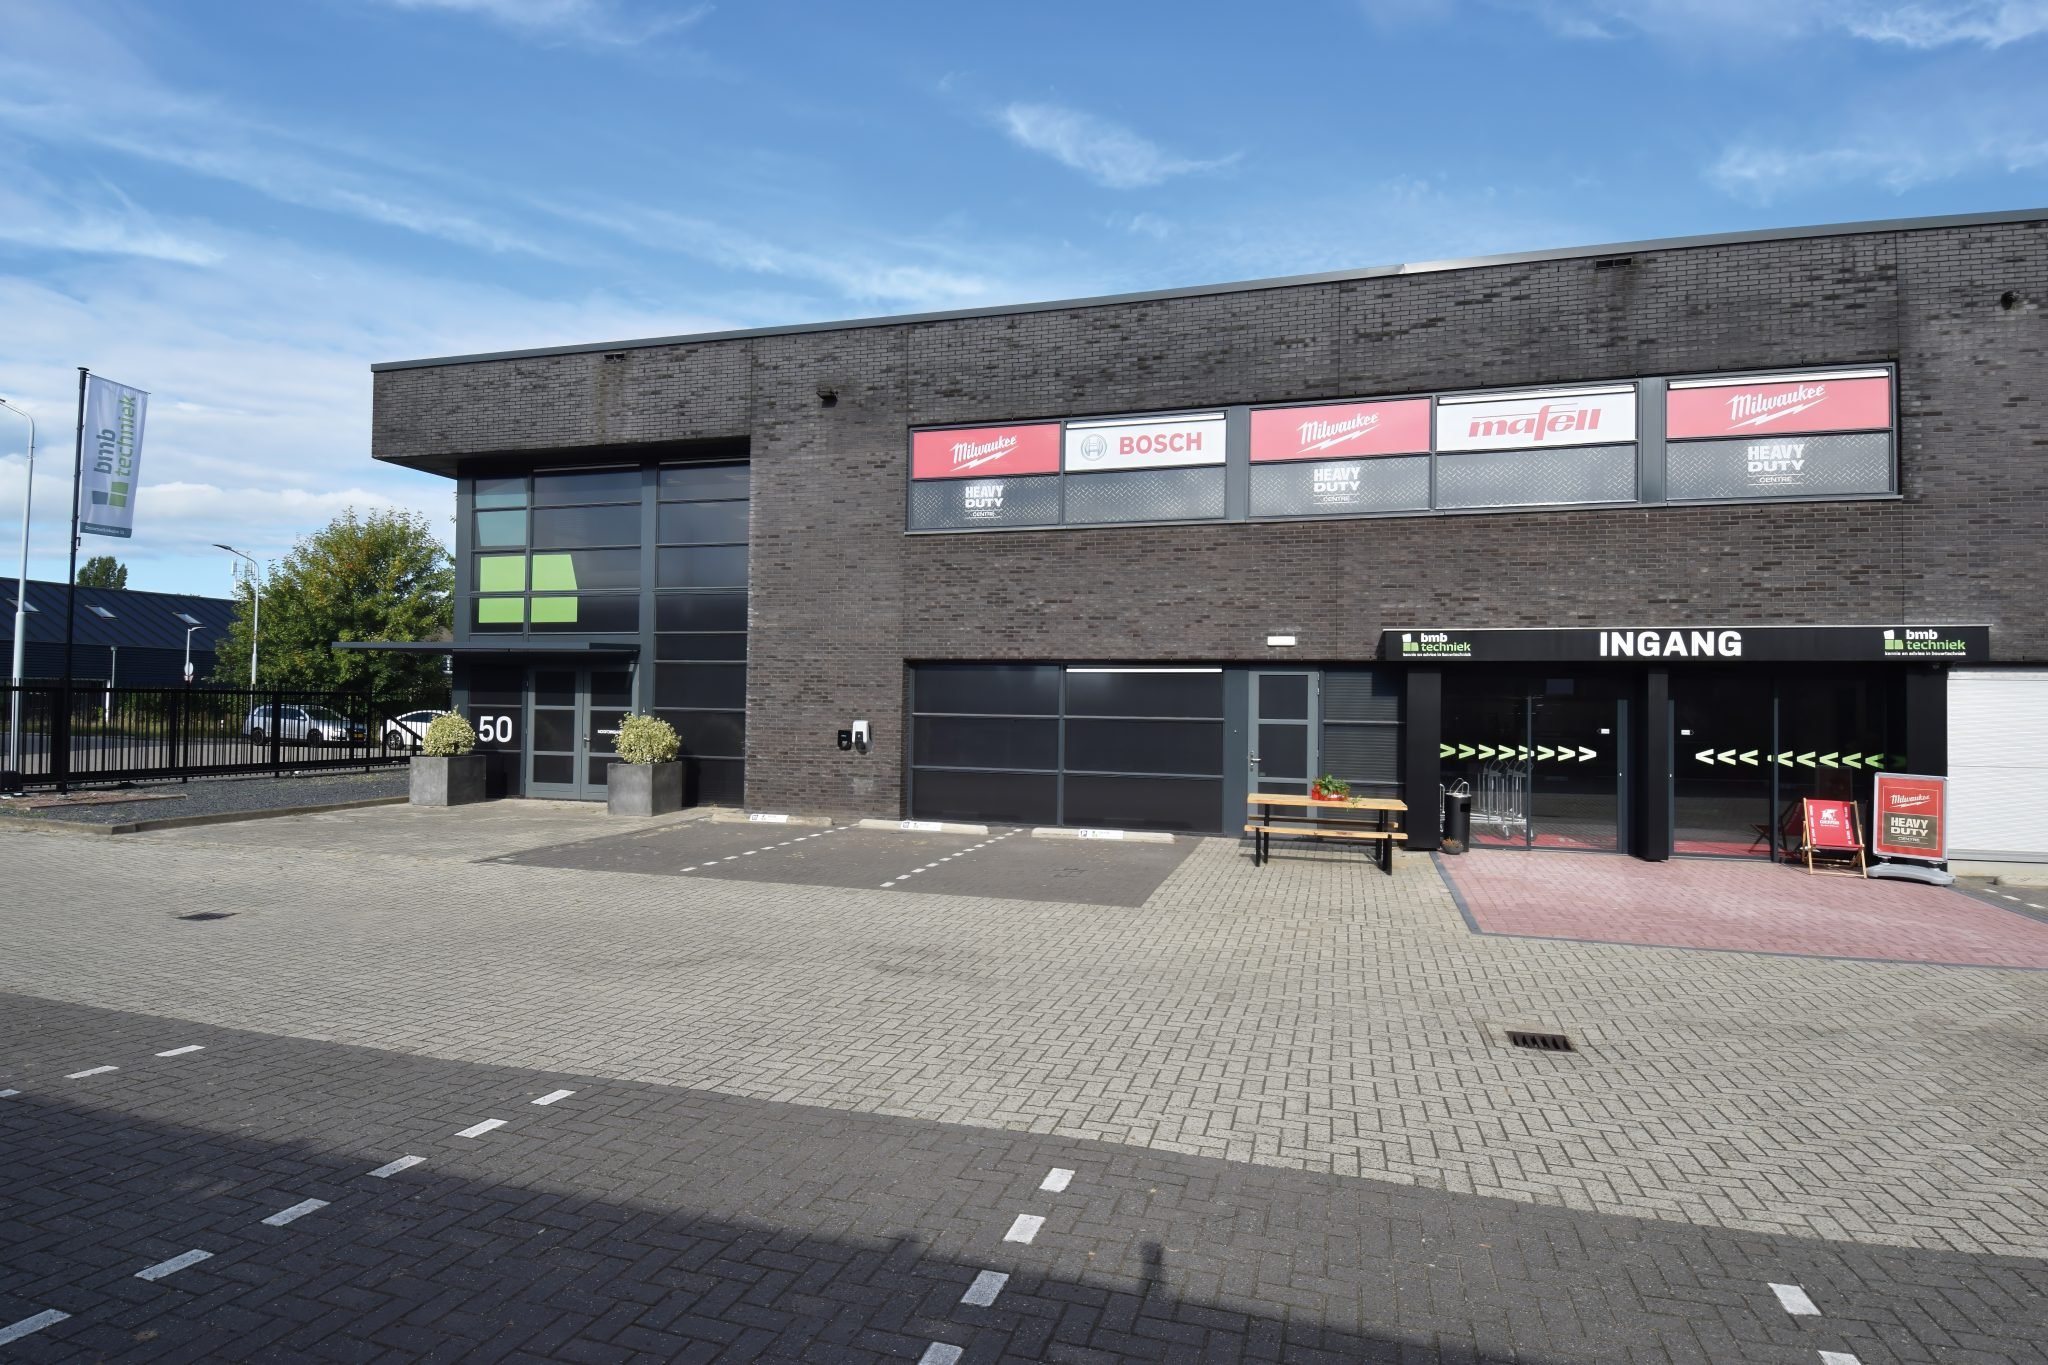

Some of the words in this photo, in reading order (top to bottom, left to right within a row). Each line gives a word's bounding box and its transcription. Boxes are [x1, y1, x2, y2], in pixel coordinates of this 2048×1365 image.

[1725, 384, 1825, 421] Milwaukee
[1297, 412, 1379, 445] Milwaukee
[1469, 403, 1602, 441] mafell
[115, 394, 137, 477] techniek
[949, 435, 1017, 464] Milwaukee
[1119, 431, 1202, 455] BOSCH
[93, 429, 116, 475] bmb
[1747, 443, 1805, 461] HEAVY
[1747, 459, 1805, 472] DUTY
[1313, 466, 1361, 482] HEAVY
[1759, 475, 1793, 483] CENTRE
[965, 485, 1004, 498] HEAVY
[1313, 481, 1361, 493] DUTY
[965, 497, 1003, 508] DUTY
[1420, 632, 1448, 643] bmb
[1905, 629, 1938, 640] bmb
[1420, 642, 1471, 652] techniek
[1600, 630, 1742, 657] INGANG
[1906, 639, 1966, 650] techniek
[479, 715, 512, 743] 50
[1890, 794, 1931, 804] Milwaukee
[1890, 816, 1929, 829] HEAVY
[1890, 827, 1929, 837] DUTY
